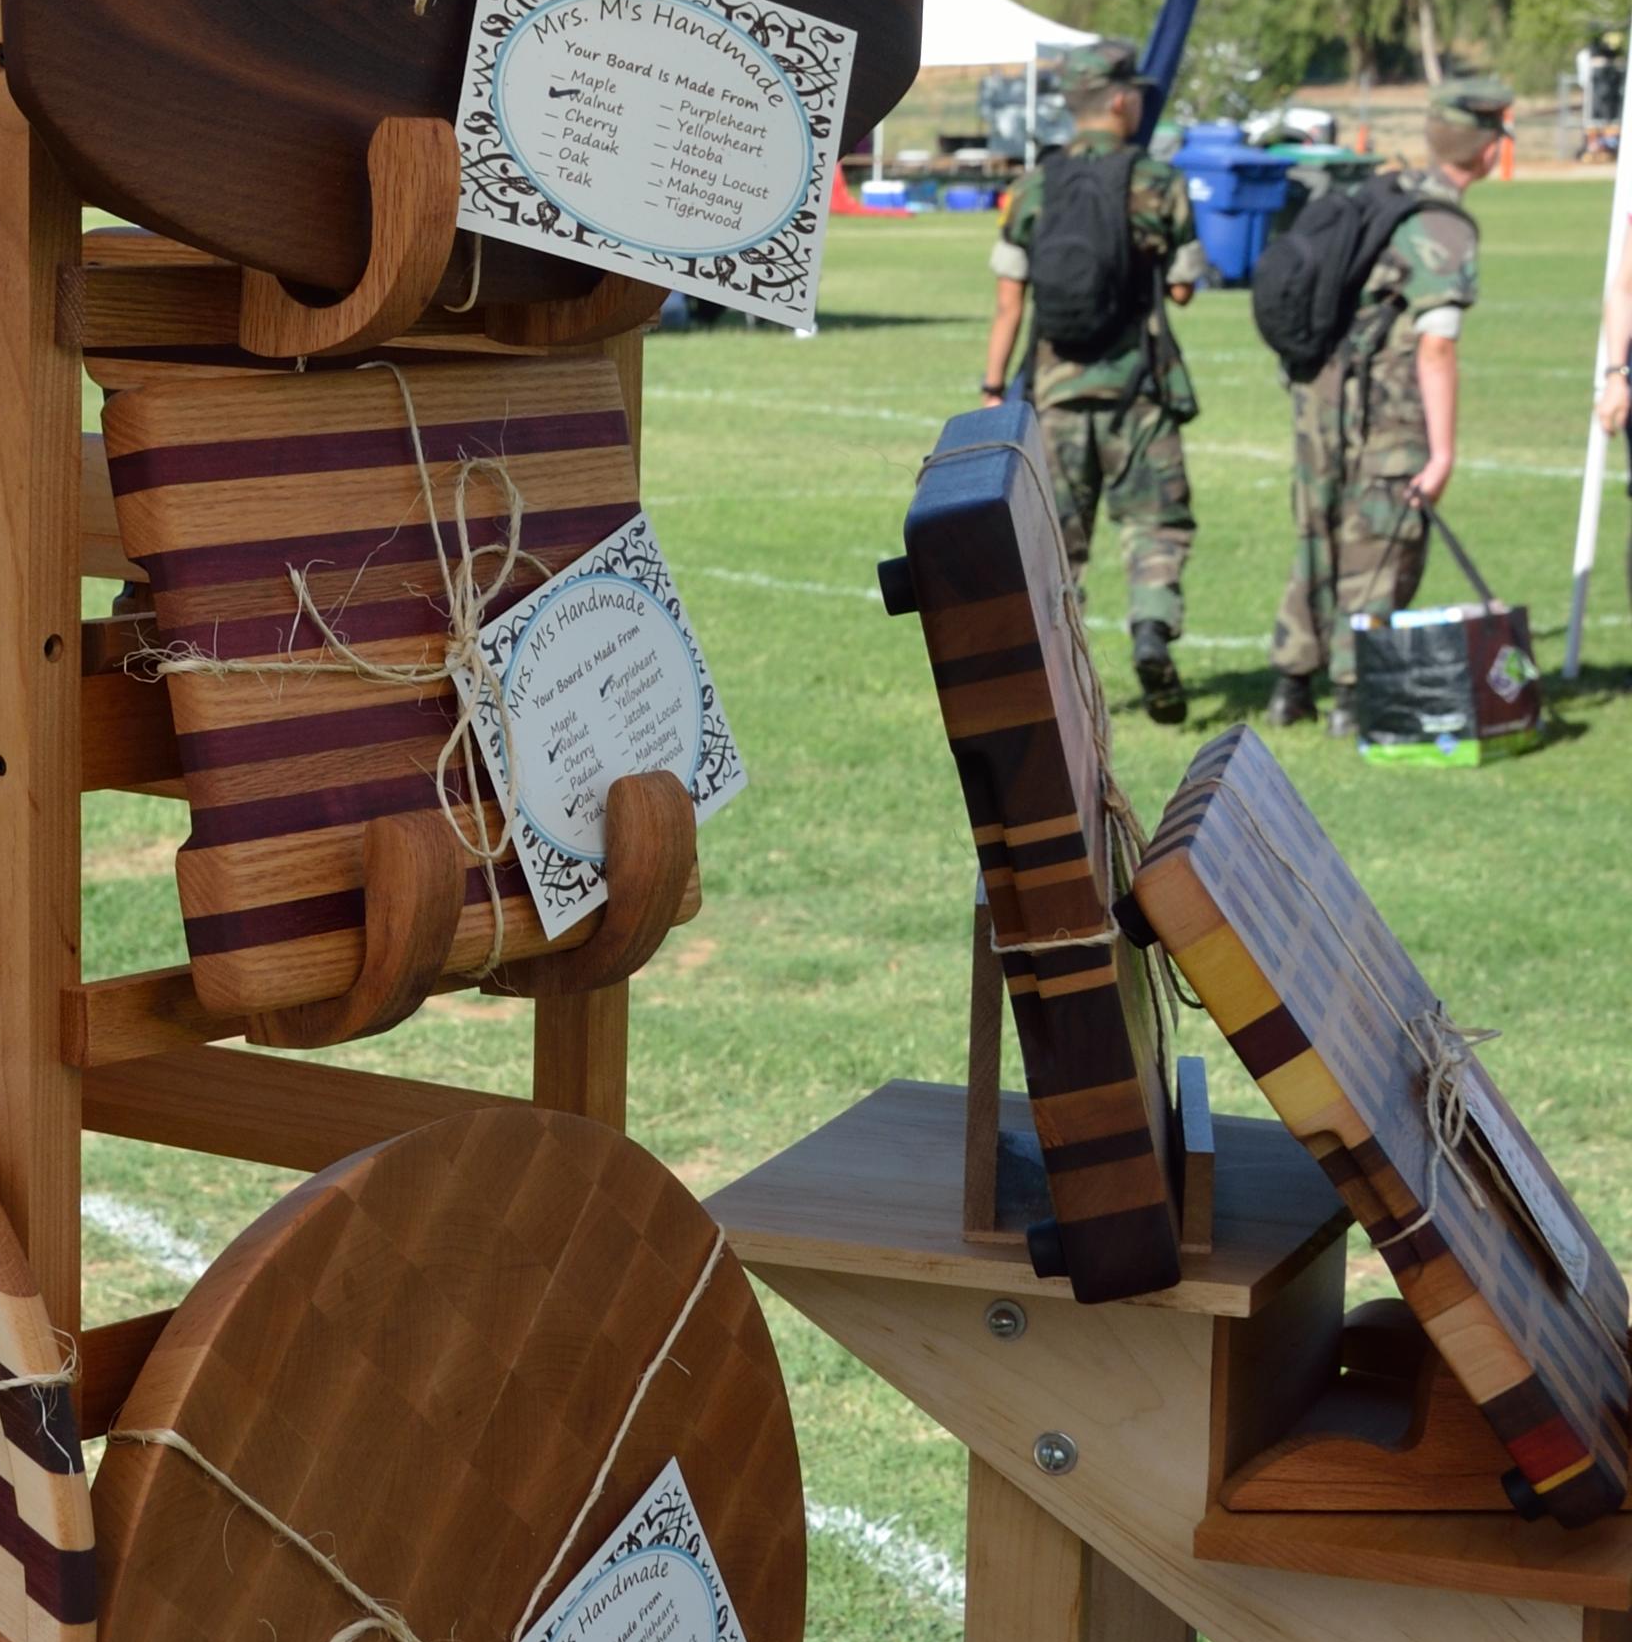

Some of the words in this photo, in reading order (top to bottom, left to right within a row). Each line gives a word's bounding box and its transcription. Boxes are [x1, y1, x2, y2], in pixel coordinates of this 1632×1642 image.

[532, 6, 589, 44] Mrs.
[599, 0, 642, 21] M's
[653, 4, 784, 108] Handmade
[564, 40, 602, 65] Your
[605, 52, 653, 78] Board
[658, 70, 669, 84] Is
[675, 76, 715, 97] Made
[721, 89, 758, 111] From
[571, 70, 617, 94] Maple
[567, 90, 624, 116] Walnut
[564, 108, 619, 137] Cherry
[679, 100, 768, 139] Purpleheart
[562, 128, 620, 155] Padauk
[673, 138, 724, 164] Jatoba
[677, 119, 763, 157] Yellowheart
[558, 146, 589, 166] Oak
[556, 166, 592, 188] Teak
[669, 158, 719, 189] Honey
[722, 174, 770, 200] Locust
[667, 178, 743, 214] Mahogany
[665, 196, 742, 230] Tigerwood
[508, 666, 534, 719] Mrs.
[530, 623, 556, 661] M's
[555, 587, 645, 630] Handmade
[532, 688, 555, 710] Your
[556, 668, 583, 694] Board
[593, 643, 617, 665] Made
[616, 625, 640, 647] From
[608, 650, 658, 693] Purpleheart
[613, 667, 664, 709] Yellowheart
[550, 711, 578, 740] Maple
[621, 701, 652, 728] Jatoba
[627, 717, 657, 747] Honey
[652, 698, 683, 728] Locust
[557, 725, 590, 753] Walnut
[635, 726, 678, 763] Mahogany
[563, 744, 596, 775] Cherry
[569, 761, 605, 790] Padauk
[576, 787, 596, 810] Oak
[584, 804, 607, 825] Teak
[578, 1555, 668, 1633] Handmade
[639, 1592, 662, 1621] From
